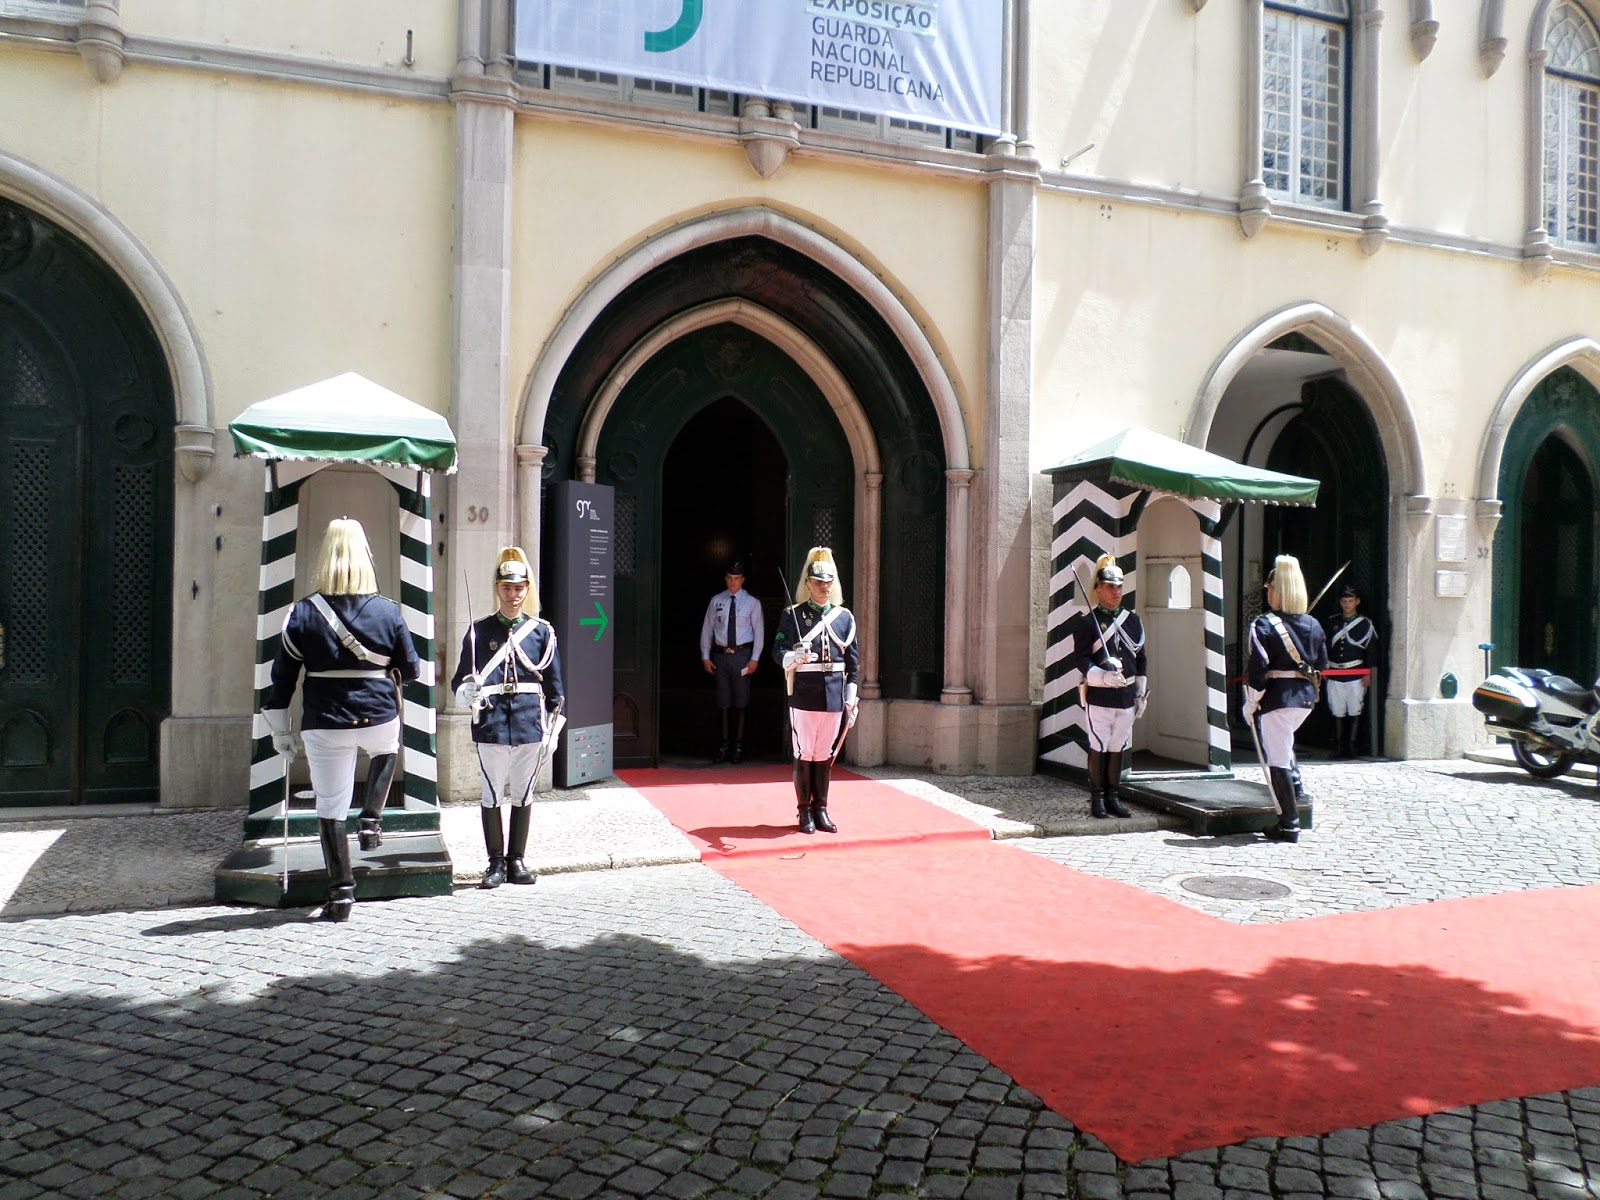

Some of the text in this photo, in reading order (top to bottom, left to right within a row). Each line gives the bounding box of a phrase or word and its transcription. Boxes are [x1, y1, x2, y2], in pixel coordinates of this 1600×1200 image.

[812, 16, 894, 49] GUARDA
[811, 38, 911, 75] NACIONAL
[810, 60, 945, 102] REPUBLICANA
[467, 505, 489, 523] 30
[1477, 547, 1489, 559] 32
